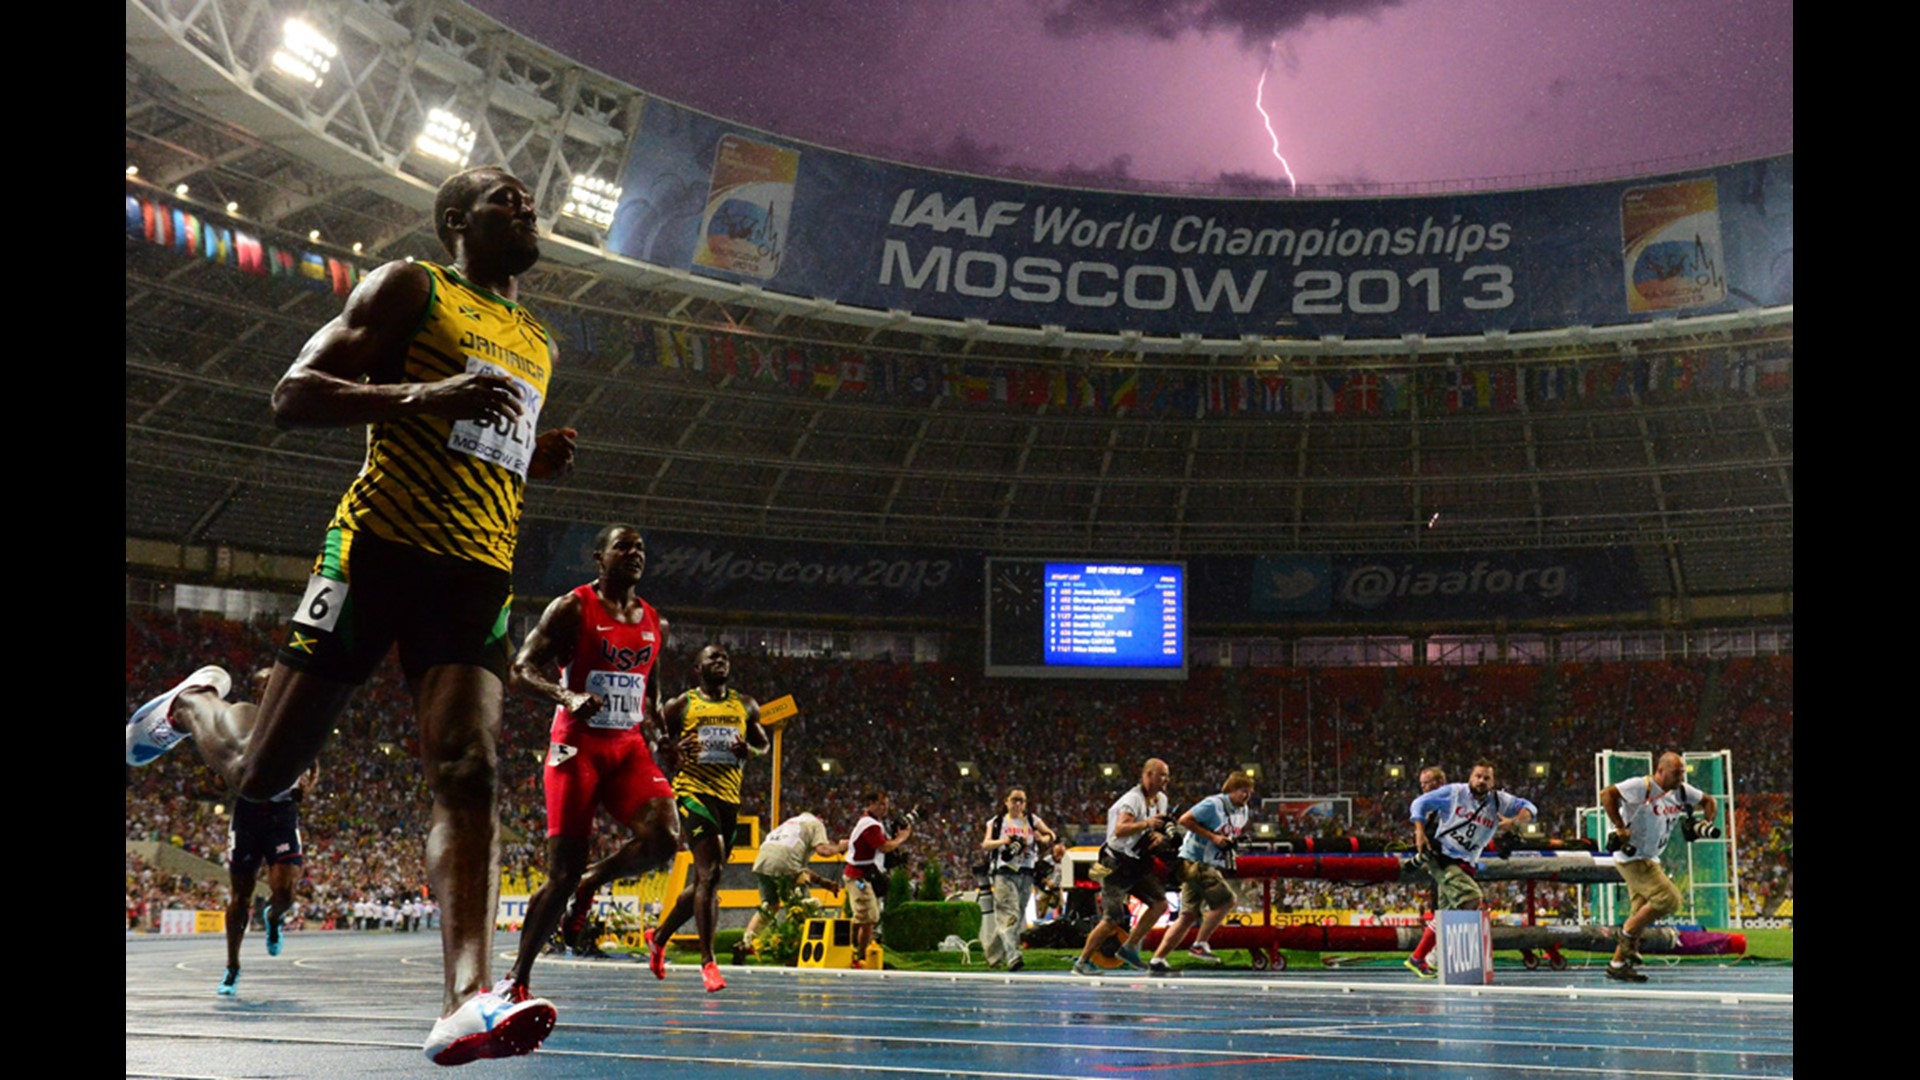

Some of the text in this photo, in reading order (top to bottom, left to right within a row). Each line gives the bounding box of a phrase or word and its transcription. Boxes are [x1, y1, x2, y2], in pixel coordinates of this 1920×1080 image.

[889, 188, 1512, 266] IAAF World Championships
[879, 239, 1515, 314] MOSCOW 2013
[459, 331, 546, 384] JAMAICA
[651, 545, 952, 590] #Moscow2013
[1343, 560, 1568, 608] @iaaforg
[309, 586, 333, 620] 6
[601, 636, 653, 671] USA
[608, 673, 642, 689] TDK
[601, 693, 641, 714] ATLIN
[1466, 823, 1477, 839] 8
[1275, 914, 1340, 927] SEIKO
[1744, 918, 1793, 929] adidas
